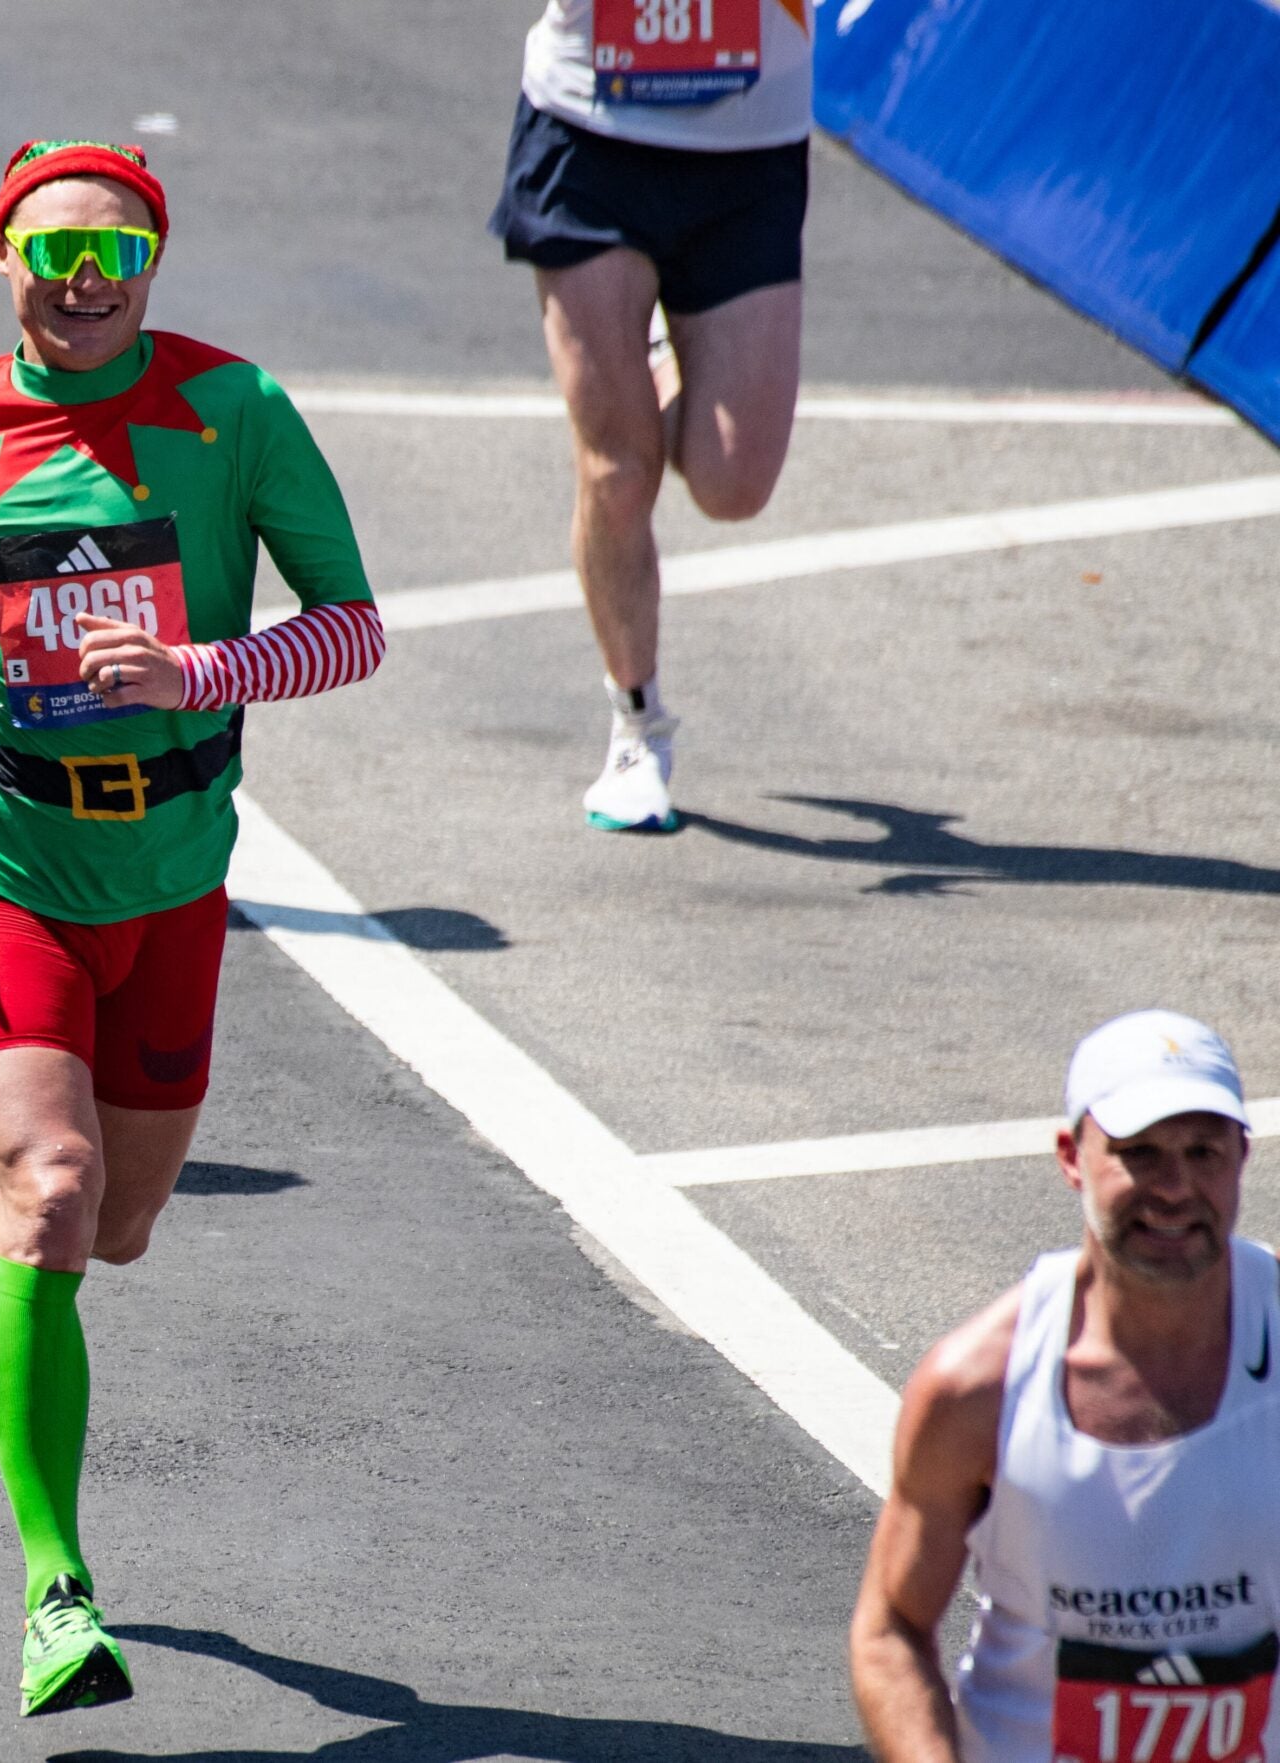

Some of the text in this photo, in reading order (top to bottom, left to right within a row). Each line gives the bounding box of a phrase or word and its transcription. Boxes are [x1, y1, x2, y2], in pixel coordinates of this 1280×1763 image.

[634, 0, 713, 44] 381
[26, 575, 158, 651] 4866
[12, 665, 23, 678] 5
[52, 708, 75, 717] BANK
[76, 704, 87, 713] OF
[73, 692, 104, 704] BOST
[1050, 1571, 1256, 1617] seacoast
[1088, 1620, 1156, 1640] TRACK
[1093, 1689, 1246, 1763] 1770
